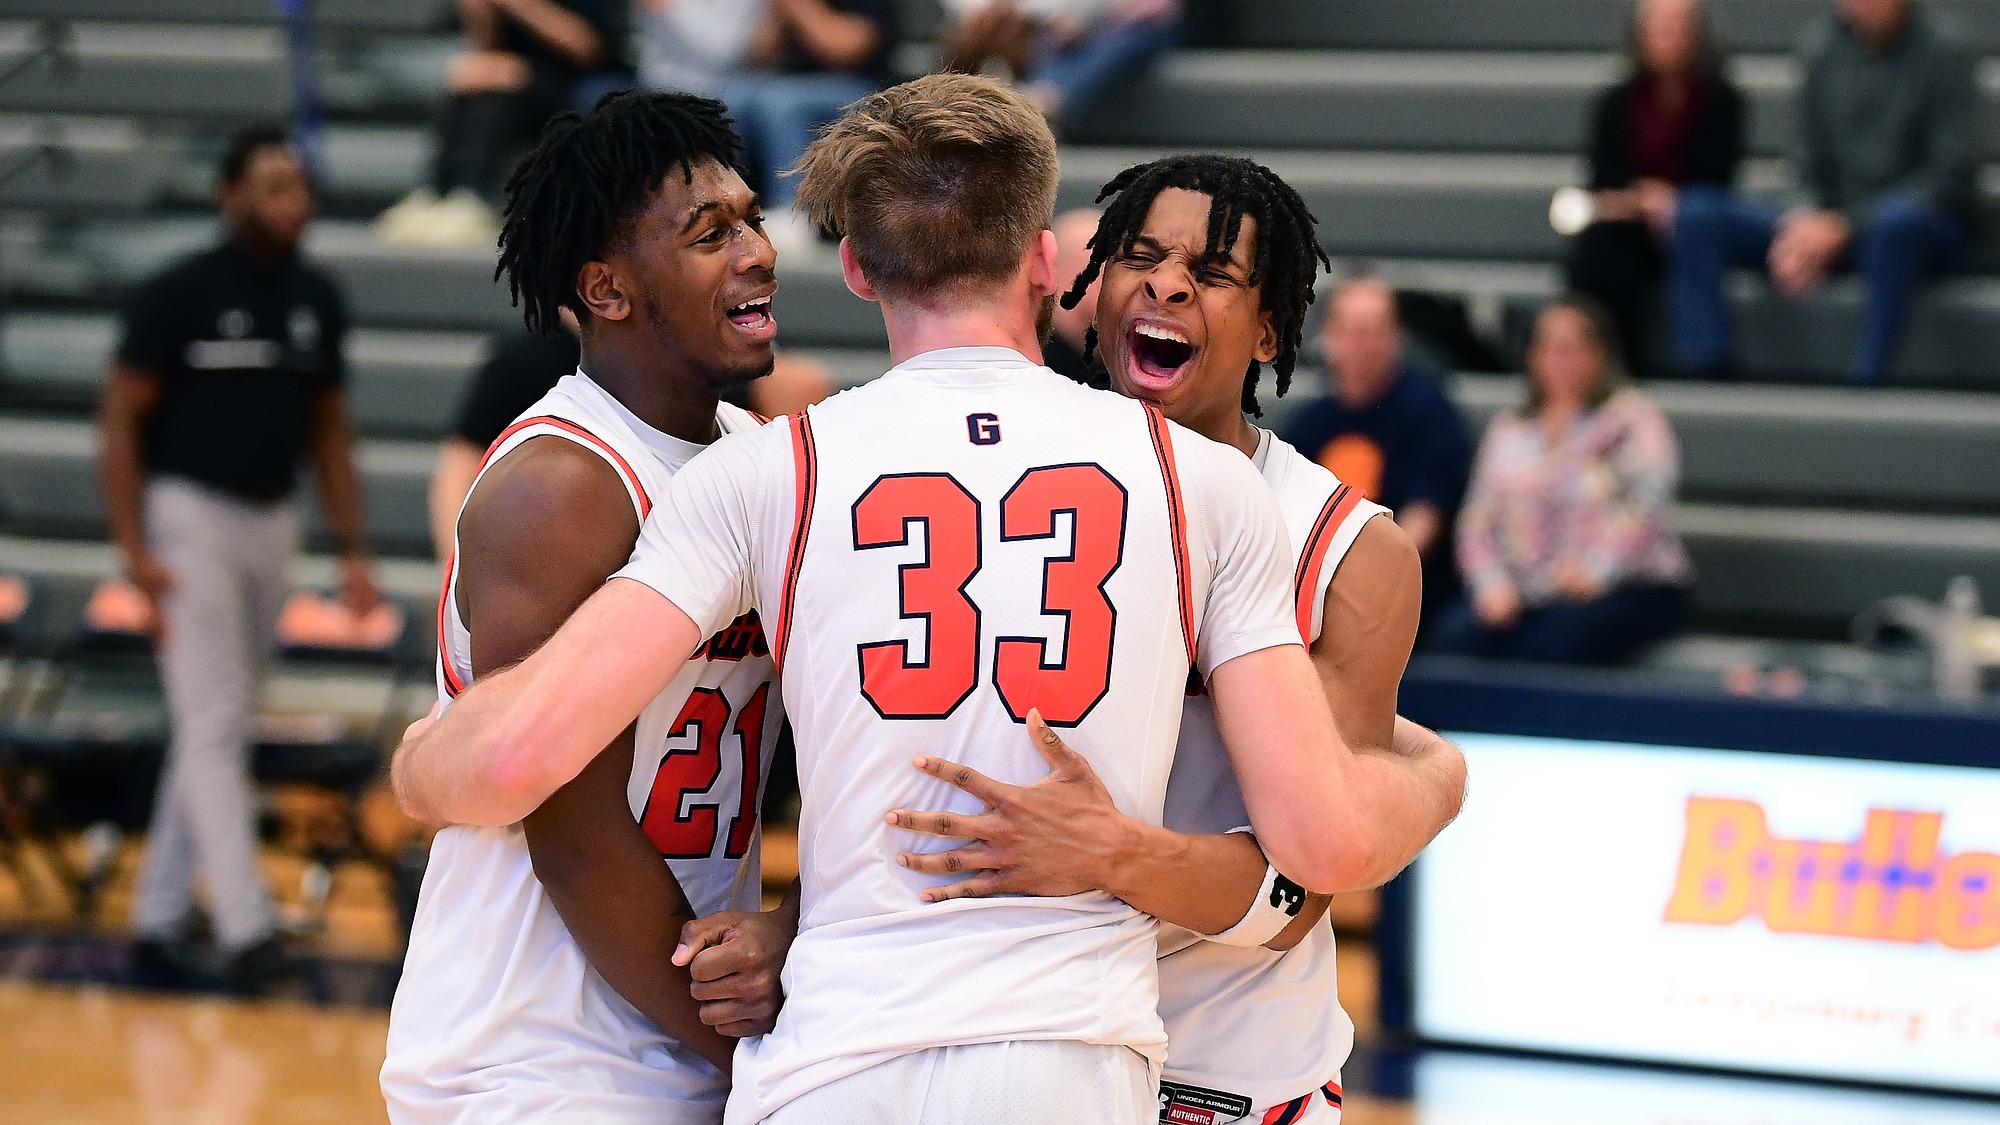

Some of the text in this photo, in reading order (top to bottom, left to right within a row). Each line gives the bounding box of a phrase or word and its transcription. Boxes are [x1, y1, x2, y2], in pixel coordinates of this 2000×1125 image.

[966, 413, 1002, 446] G
[851, 462, 1129, 728] 33
[639, 681, 770, 859] 21
[1170, 1109, 1211, 1125] AUTHENTIC
[1177, 1094, 1241, 1112] UNDER ARMOUR
